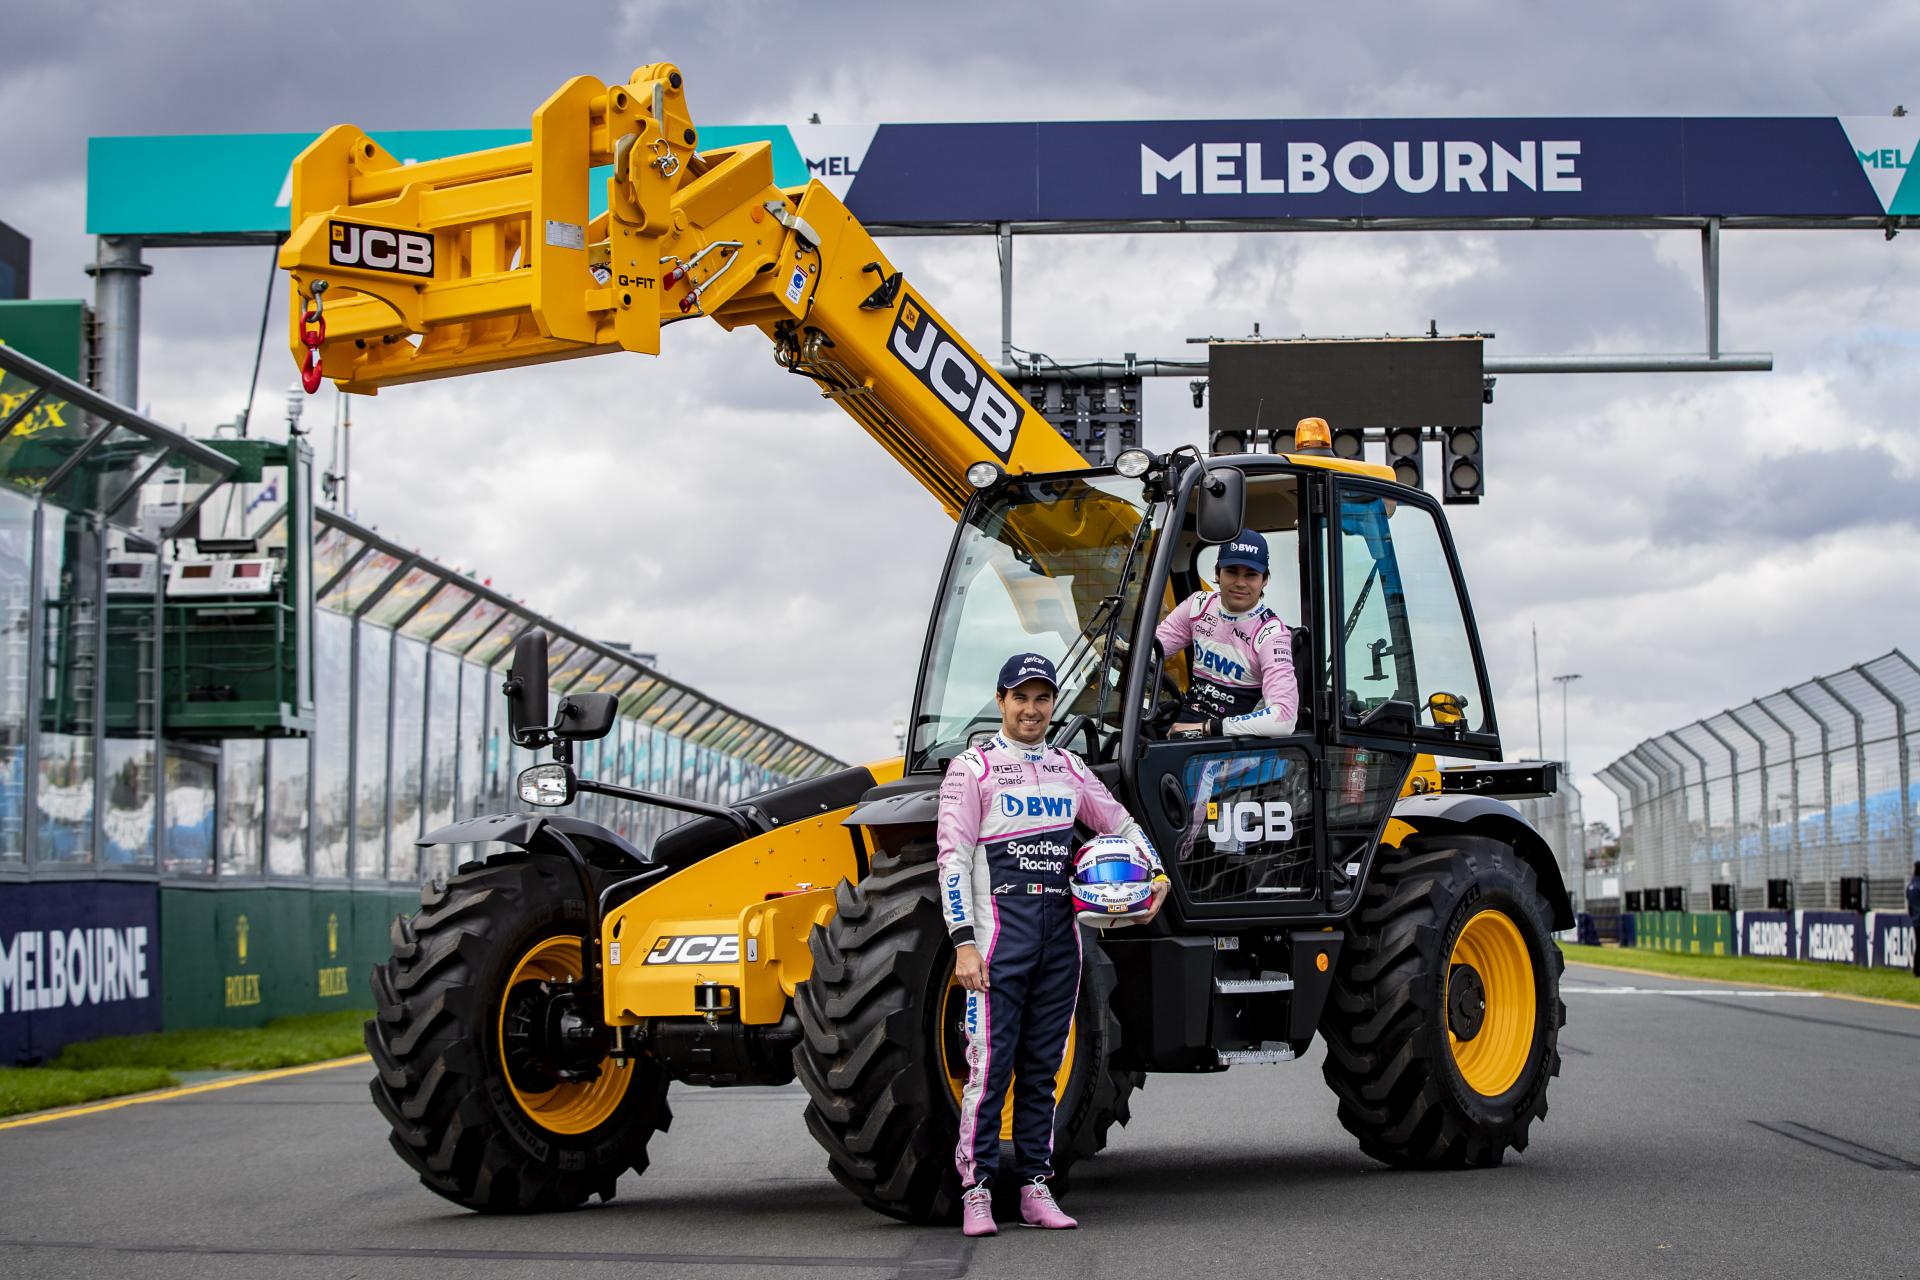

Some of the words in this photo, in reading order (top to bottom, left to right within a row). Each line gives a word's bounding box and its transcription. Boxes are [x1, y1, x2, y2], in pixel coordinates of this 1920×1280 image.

[806, 156, 858, 176] MEL
[1140, 140, 1583, 195] MELBOURNE
[1857, 149, 1909, 168] MEL
[332, 227, 433, 273] JCB
[618, 274, 656, 289] Q-FIT
[893, 321, 1018, 453] JCB
[1238, 543, 1259, 555] BWT
[1195, 625, 1214, 637] Claro
[1231, 627, 1252, 646] NEC
[1024, 655, 1046, 665] telcel
[1203, 649, 1245, 680] BWT
[993, 764, 1022, 773] JCB
[1042, 765, 1067, 774] NEC
[998, 776, 1023, 785] Claro
[1026, 796, 1073, 818] BWT
[1207, 801, 1294, 843] JCB
[1019, 857, 1063, 875] Racing
[948, 889, 966, 922] BWT
[1083, 890, 1100, 902] BWT
[647, 936, 739, 963] JCB
[1750, 921, 1788, 956] MELBOURNE
[1809, 923, 1854, 962] MELBOURNE
[0, 926, 149, 1014] MELBOURNE
[225, 974, 261, 1008] ROLEX
[967, 996, 977, 1034] BWT
